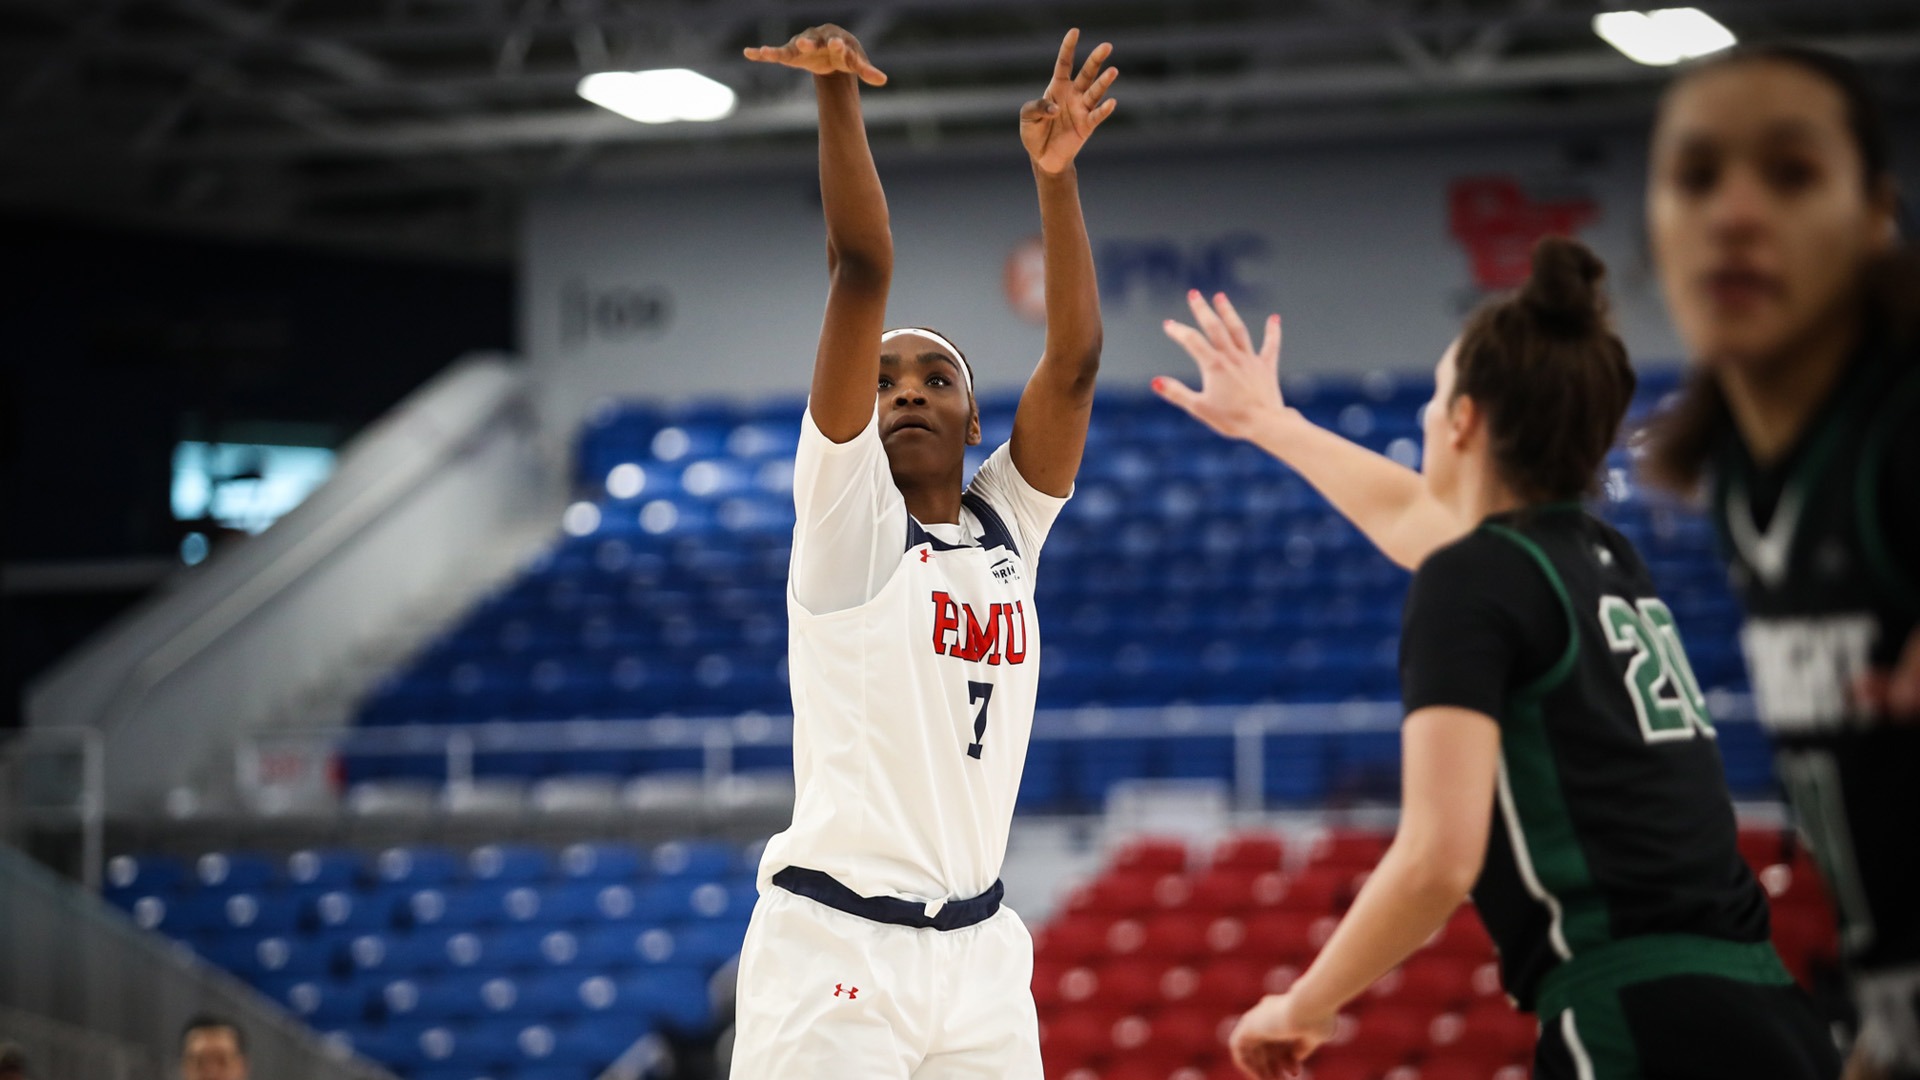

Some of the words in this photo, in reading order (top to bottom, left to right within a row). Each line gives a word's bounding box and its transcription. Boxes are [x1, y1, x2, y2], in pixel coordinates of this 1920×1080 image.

[931, 590, 1027, 666] RMU
[1598, 595, 1717, 744] 20
[966, 680, 994, 760] 7
